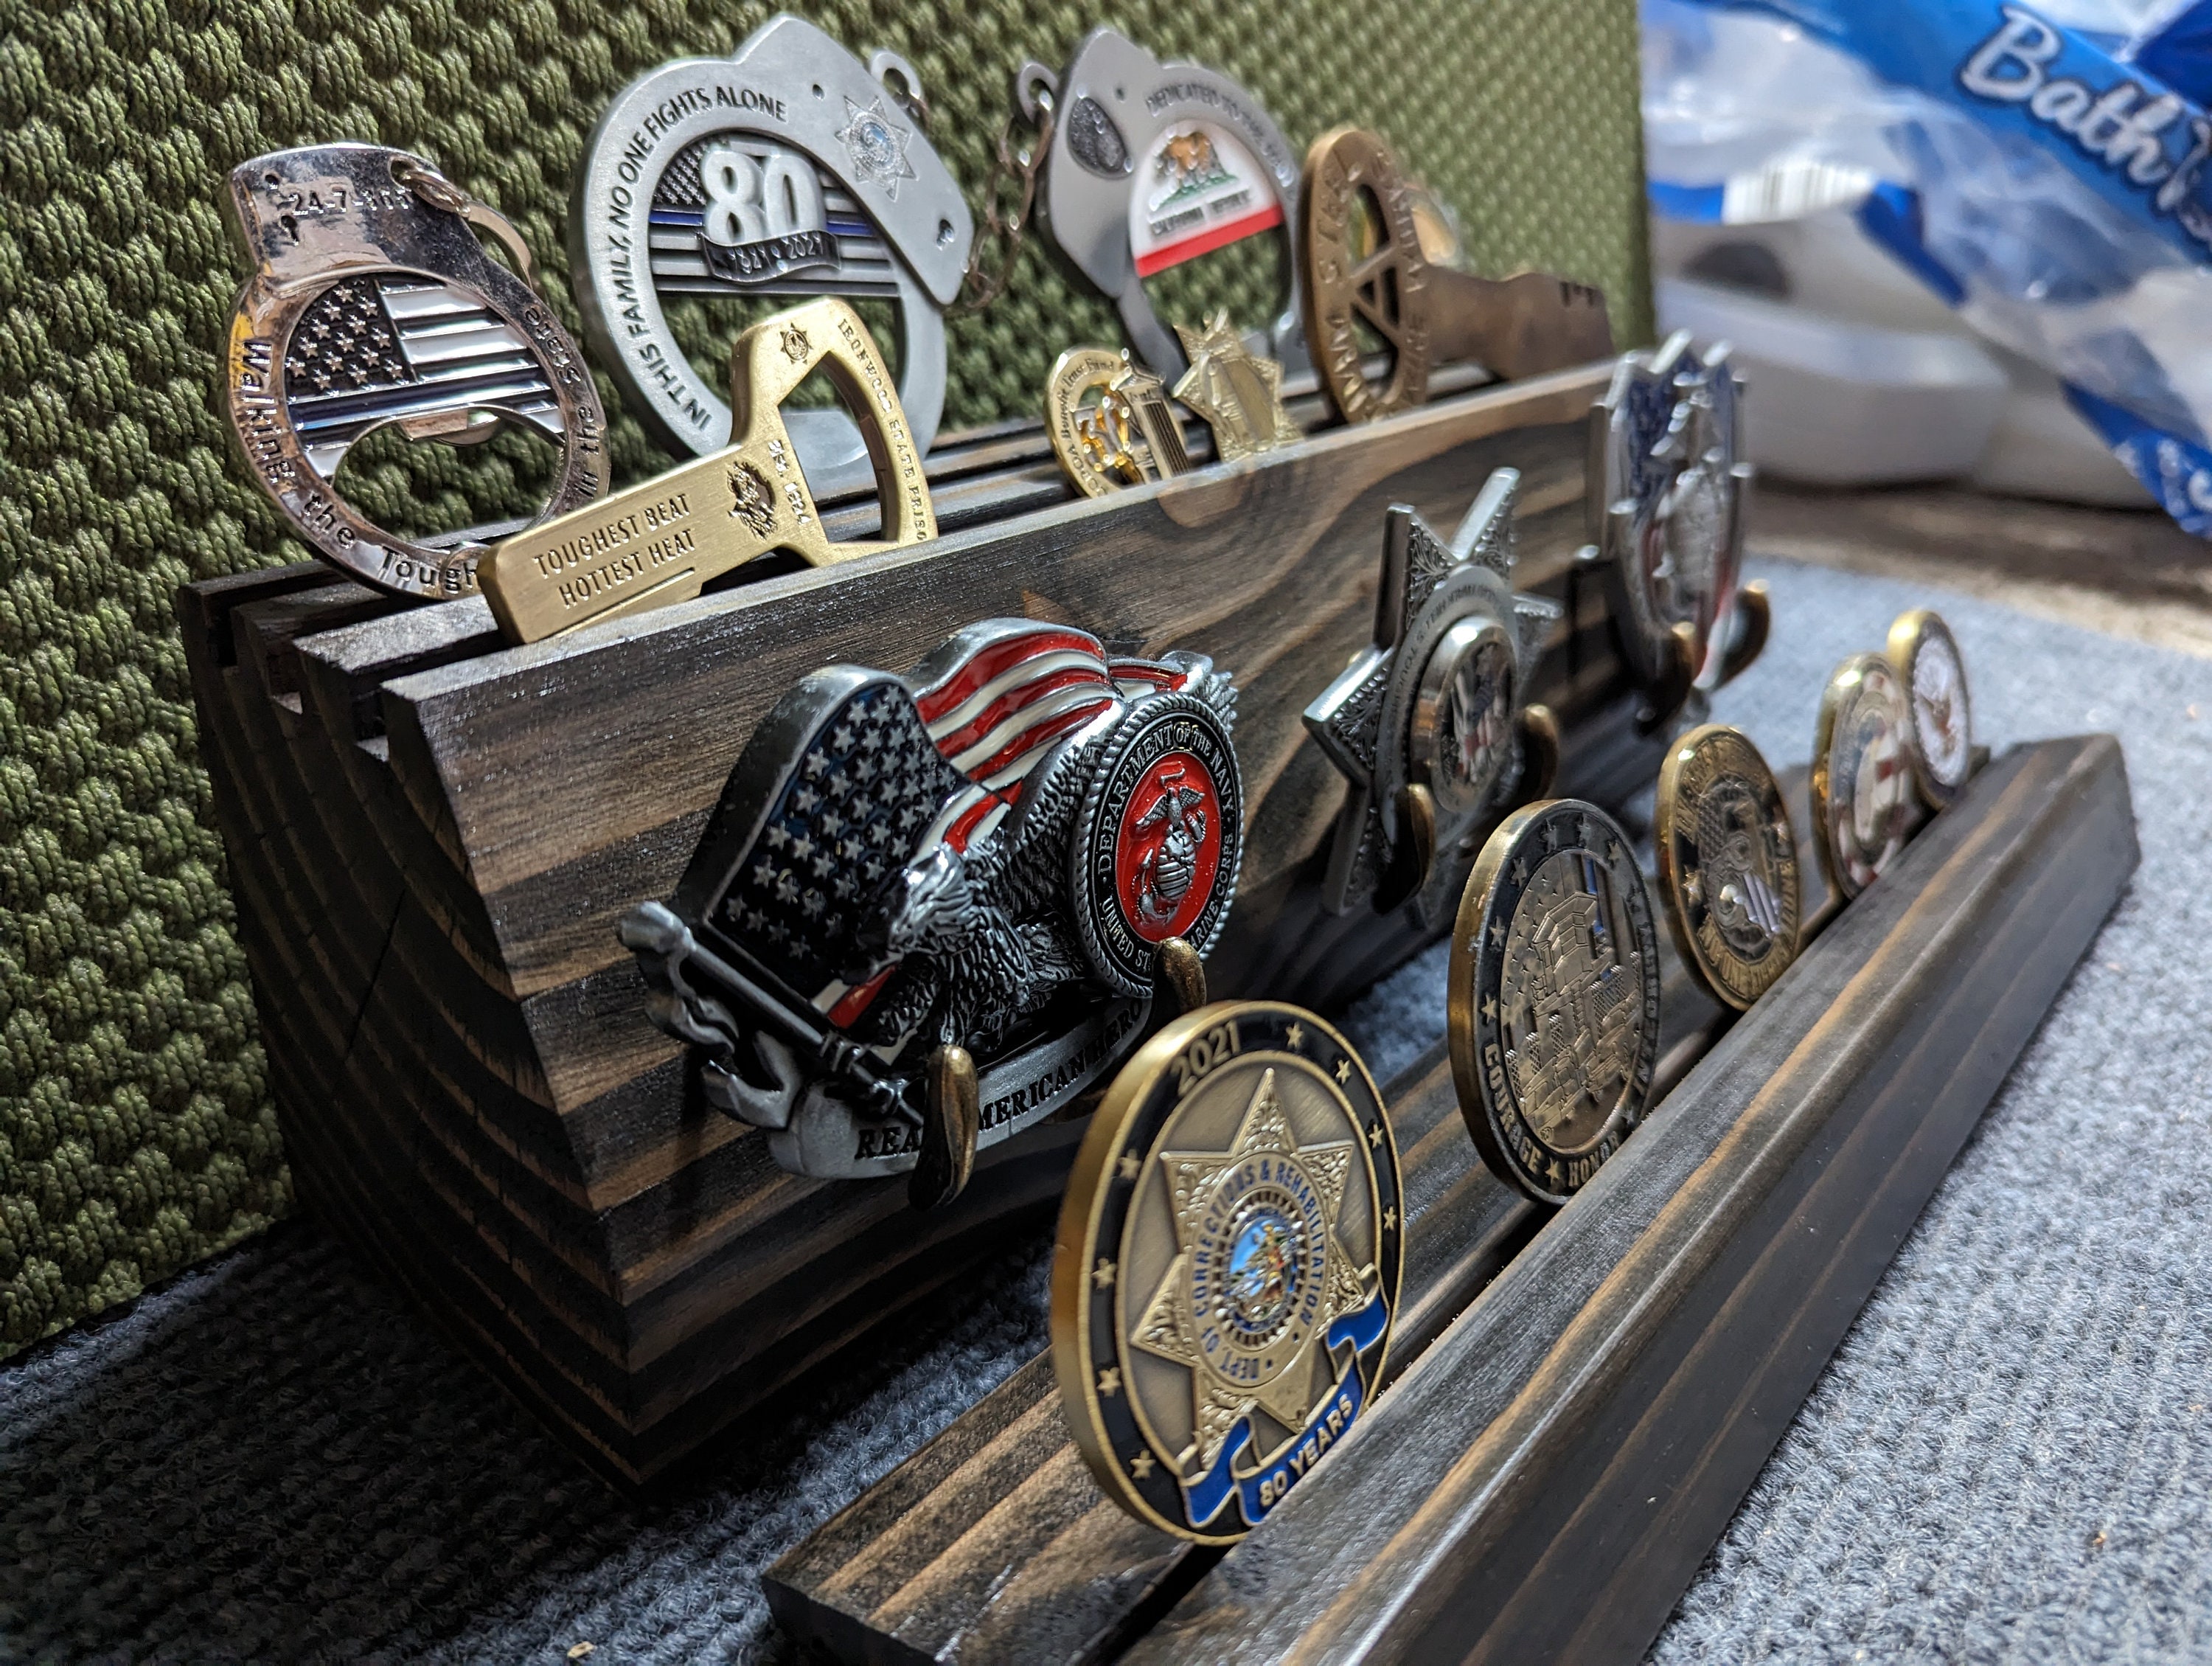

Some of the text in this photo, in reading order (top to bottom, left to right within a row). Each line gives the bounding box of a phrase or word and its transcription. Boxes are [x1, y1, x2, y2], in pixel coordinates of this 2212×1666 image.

[643, 86, 713, 142] FIGHTS
[716, 86, 787, 123] ALONE
[1960, 4, 2181, 184] Bath
[617, 131, 655, 185] ONE
[700, 149, 828, 246] 80
[610, 185, 634, 226] NO
[639, 344, 686, 405] THIS
[684, 398, 712, 431] IN
[302, 493, 355, 547] the
[533, 493, 692, 579] TOUGHEST BEAT
[908, 485, 928, 542] PRISO
[559, 529, 696, 609] HOTTEST HEAT
[1099, 723, 1234, 875] DEPARTMENT OF THE NAVY
[1101, 833, 1234, 959] UNITED ARINE CORPS
[1169, 1020, 1240, 1097] 2021
[855, 1127, 922, 1160] REA
[978, 1047, 1087, 1131] MERICAN
[1484, 1042, 1545, 1175] COURAGE
[1276, 1160, 1325, 1326] REHABILITATION
[1259, 1393, 1353, 1507] 80 YEARS
